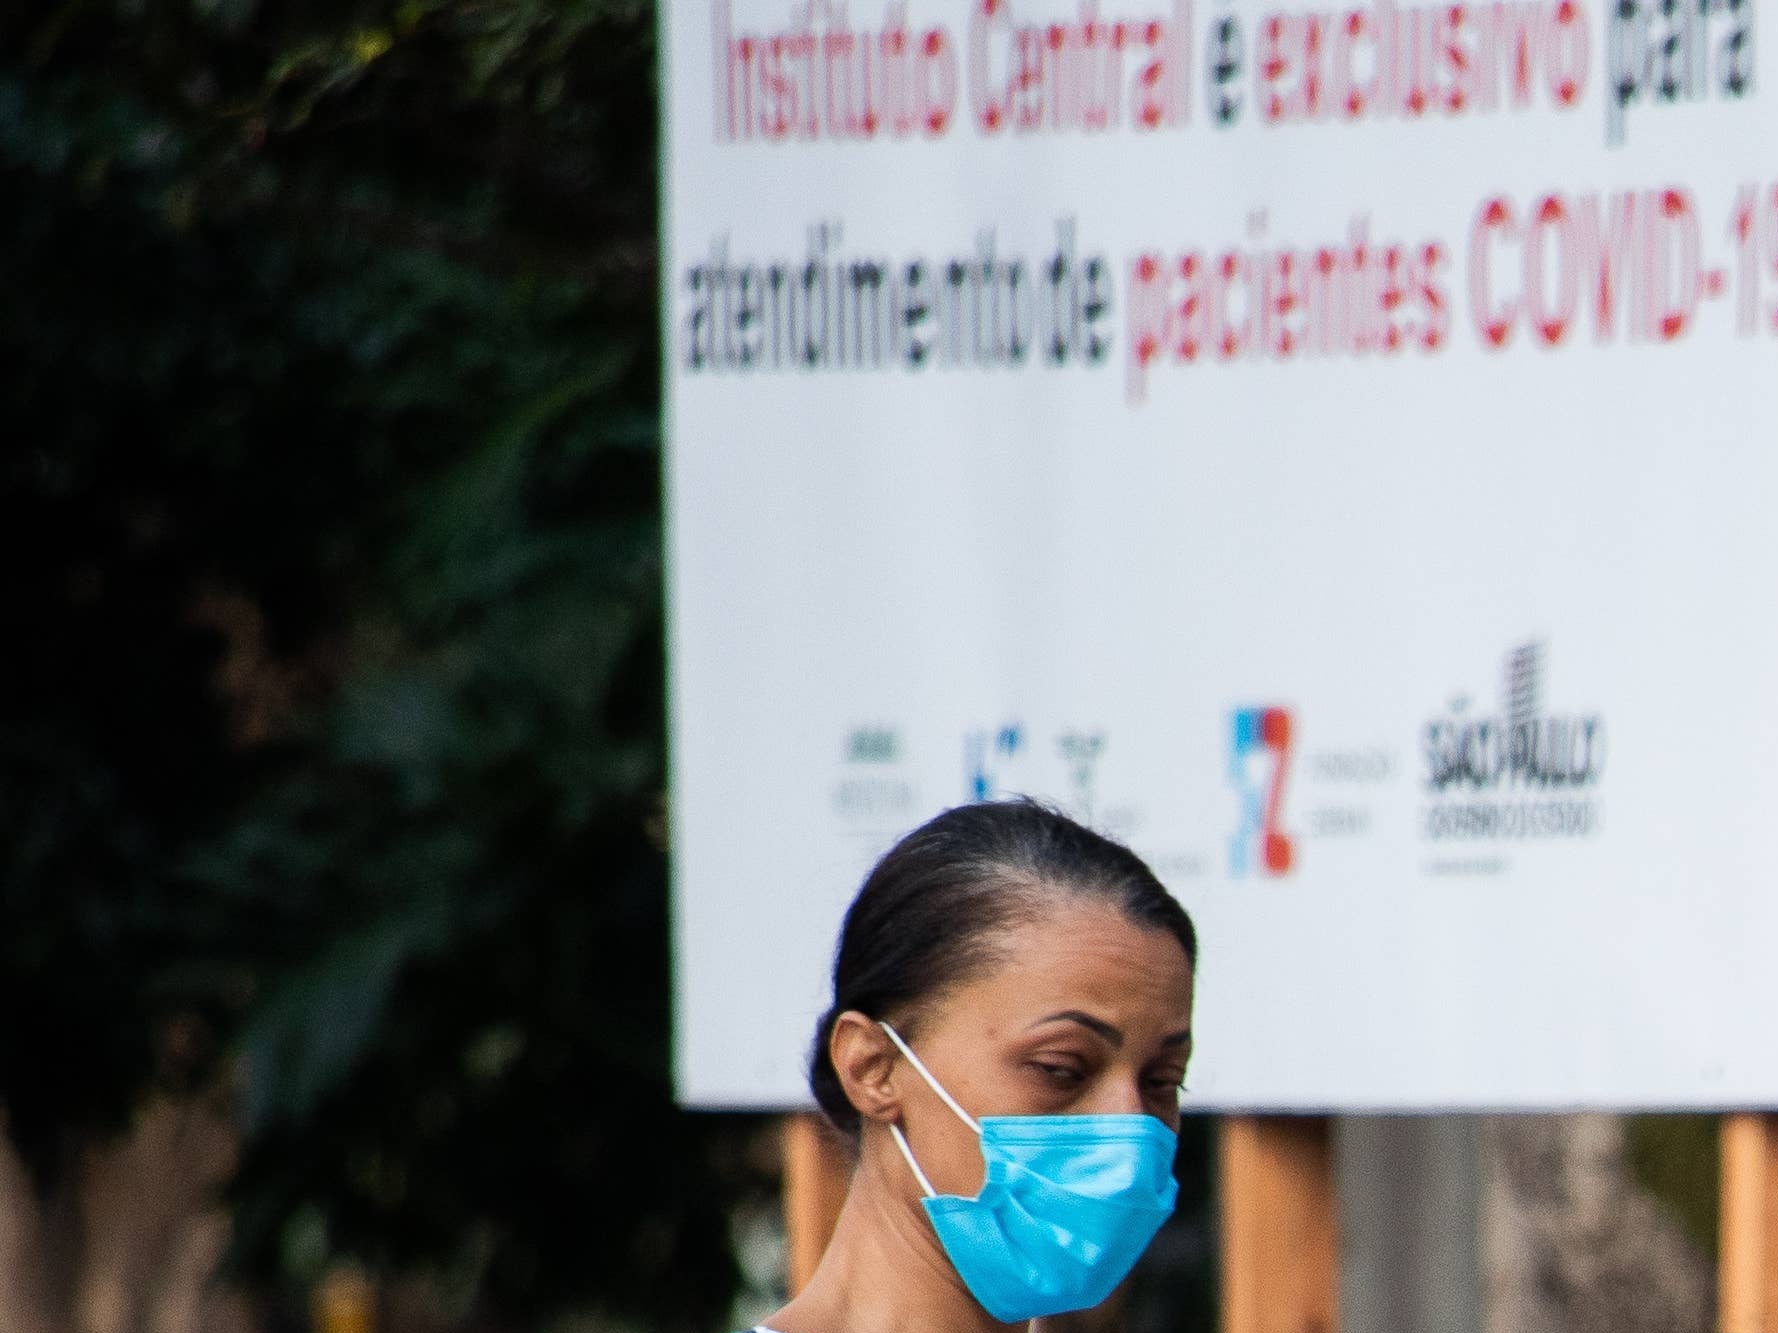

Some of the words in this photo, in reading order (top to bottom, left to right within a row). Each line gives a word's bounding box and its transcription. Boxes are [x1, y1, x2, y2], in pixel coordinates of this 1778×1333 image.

[710, 0, 961, 144] Instituto
[966, 0, 1196, 139] Central
[1205, 13, 1243, 130] e
[1254, 0, 1593, 124] exclusivo
[1603, 0, 1759, 148] para
[684, 218, 1033, 374] atendimento
[1041, 213, 1116, 370] de
[1125, 206, 1452, 406] pacientes
